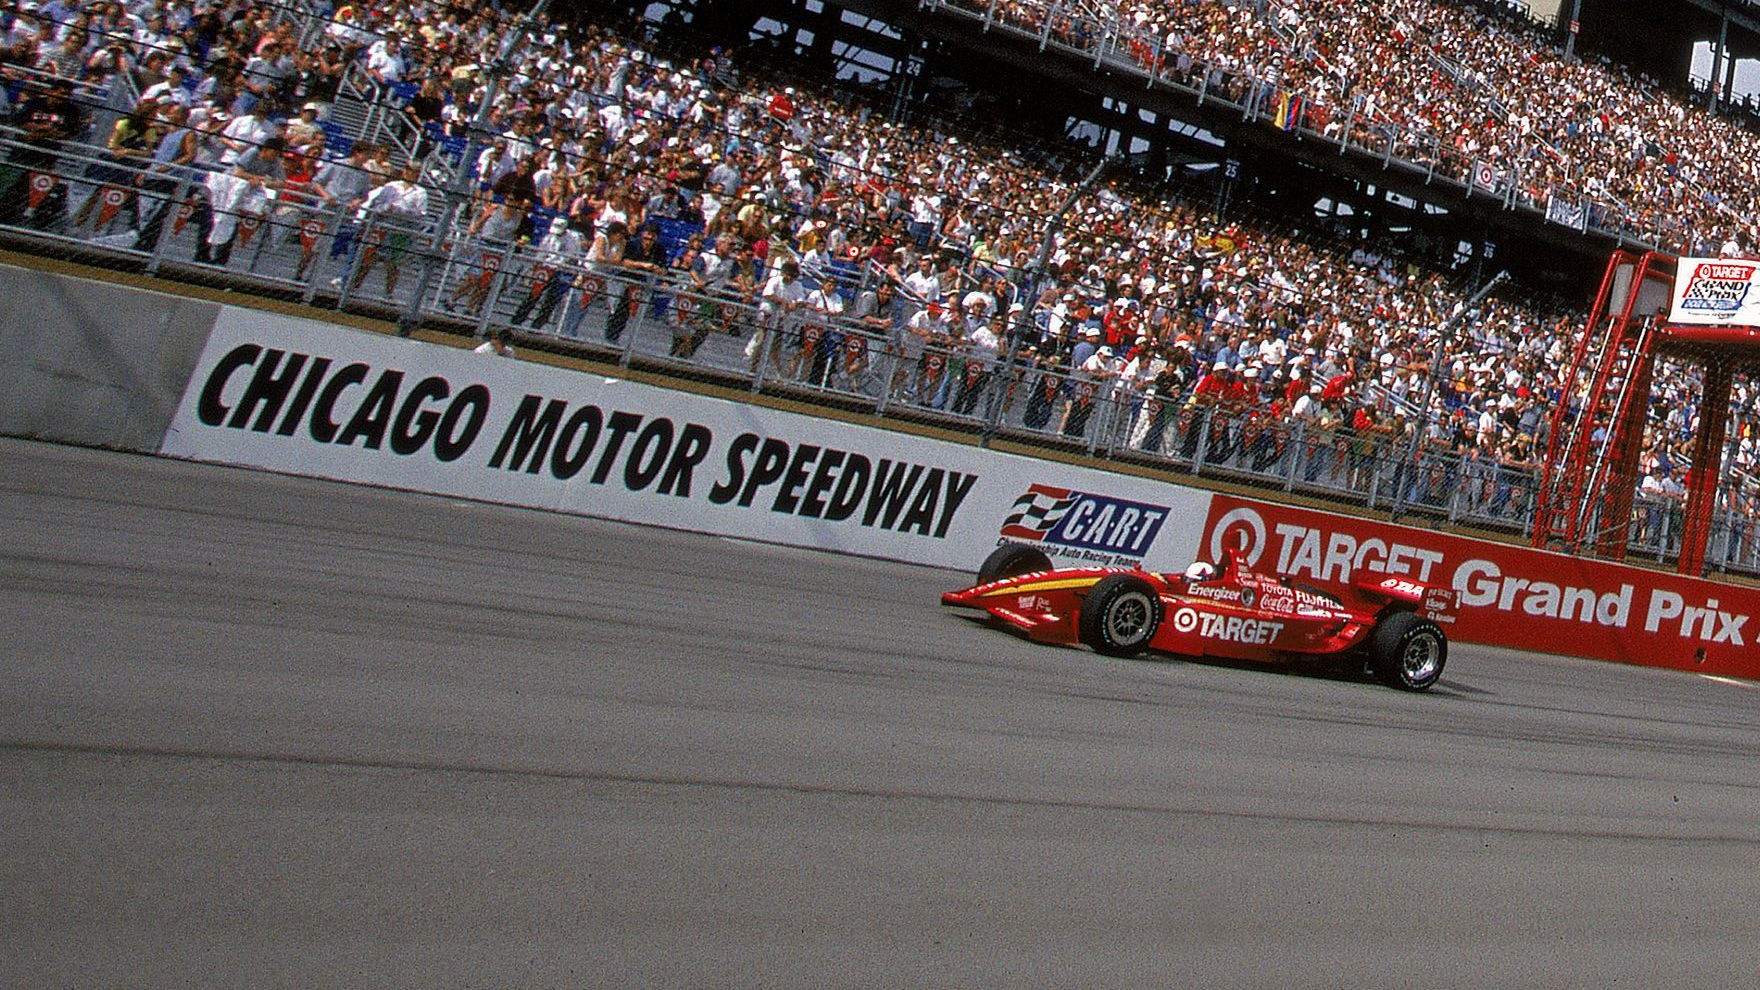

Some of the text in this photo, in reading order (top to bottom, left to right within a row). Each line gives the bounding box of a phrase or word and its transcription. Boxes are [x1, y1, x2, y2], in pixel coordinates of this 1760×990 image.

[907, 61, 921, 76] 24
[1226, 164, 1237, 178] 25
[1711, 265, 1748, 279] TARGET
[1694, 279, 1744, 291] GRAND
[197, 343, 979, 539] CHICAGO MOTOR SPEEDWAY
[1059, 547, 1083, 559] Auto
[1083, 552, 1113, 566] Racing
[1187, 582, 1241, 601] Energizer
[1261, 583, 1293, 597] TOYOTA
[1275, 523, 1444, 584] TARGET
[1452, 559, 1634, 628] Grand
[1644, 588, 1749, 647] Prix
[1199, 612, 1284, 645] TARGET
